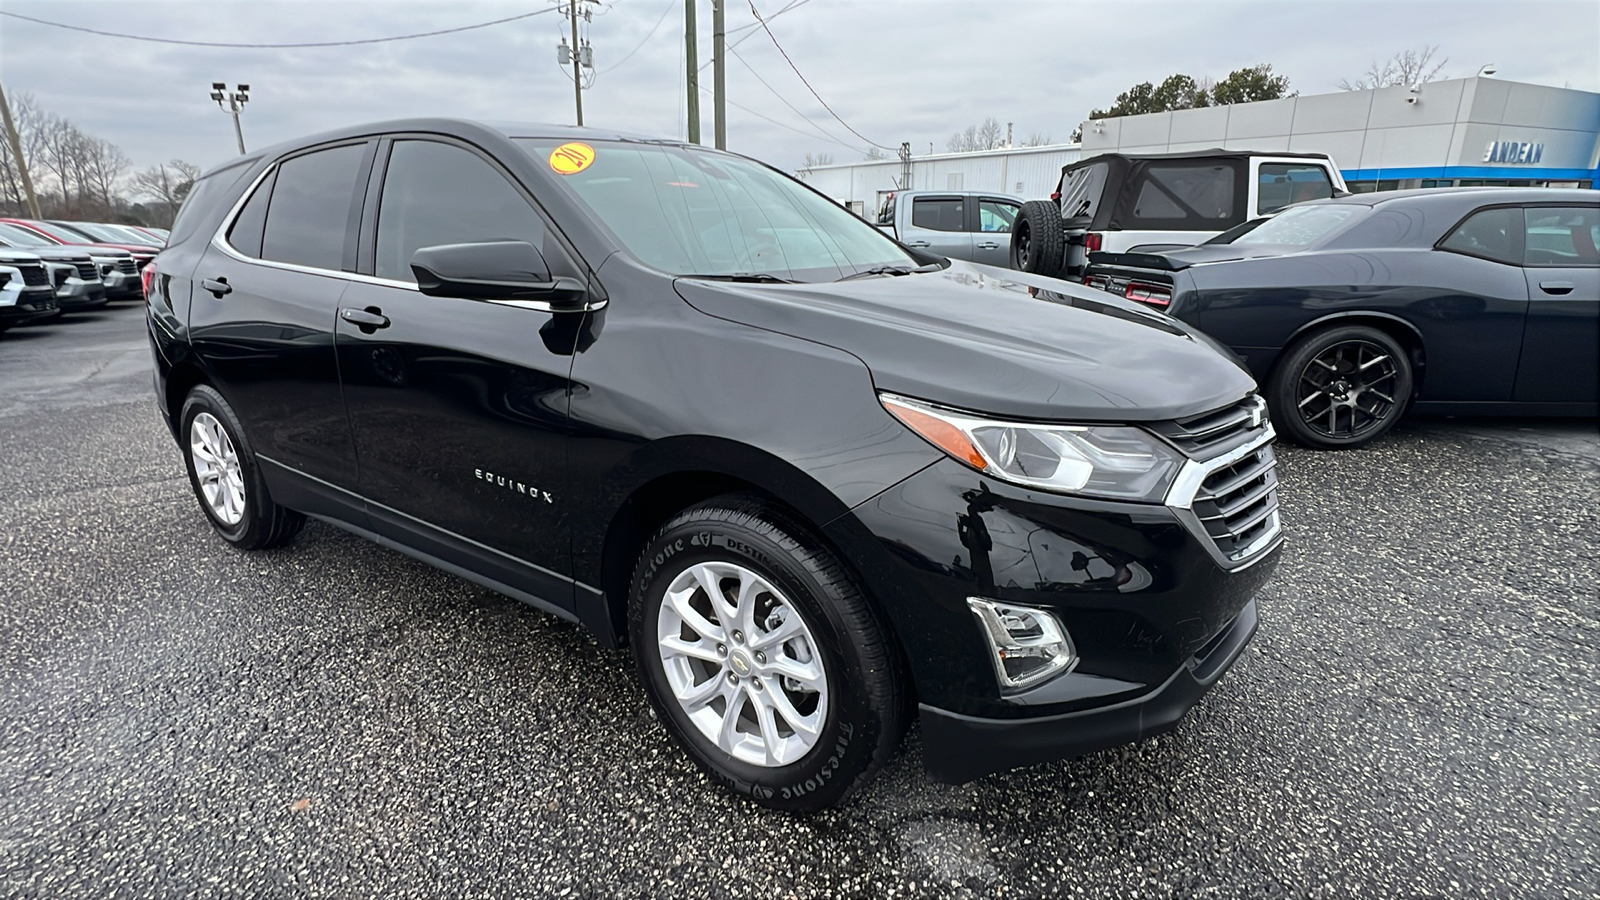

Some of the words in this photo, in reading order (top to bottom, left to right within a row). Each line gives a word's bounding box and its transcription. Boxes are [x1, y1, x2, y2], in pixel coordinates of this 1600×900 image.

[555, 147, 588, 168] 20
[475, 468, 554, 504] EQUINOX
[780, 720, 854, 800] Firestone
